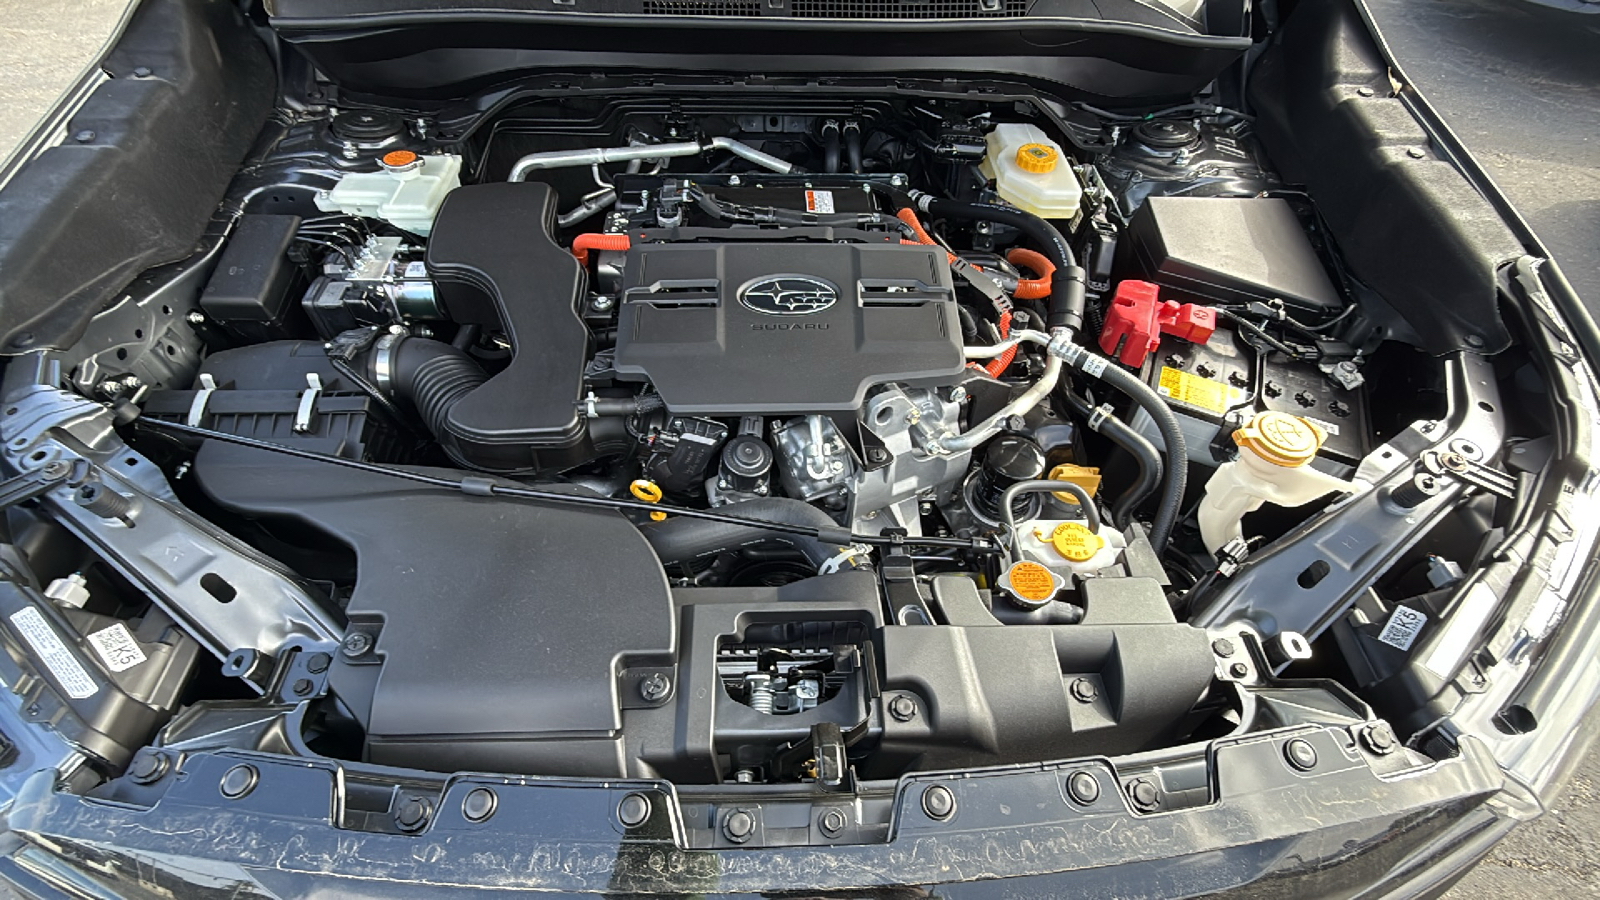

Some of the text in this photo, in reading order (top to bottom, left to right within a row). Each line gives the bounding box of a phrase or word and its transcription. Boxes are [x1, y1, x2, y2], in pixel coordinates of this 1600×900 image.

[751, 323, 829, 331] SUBARU
[1395, 611, 1418, 632] K5
[112, 644, 136, 665] K5
